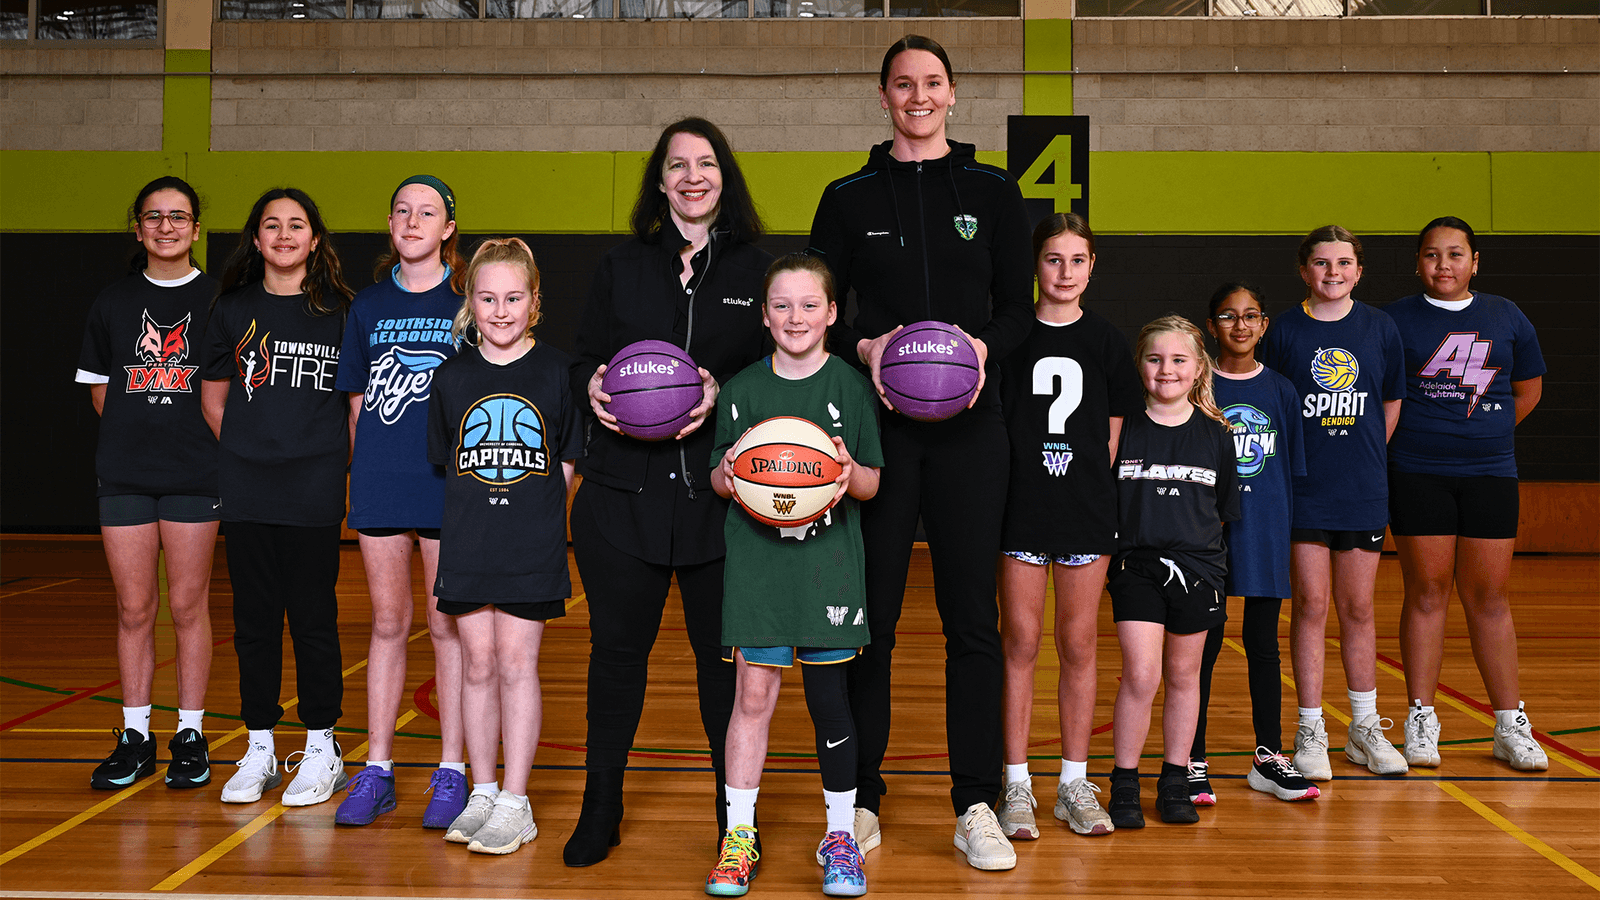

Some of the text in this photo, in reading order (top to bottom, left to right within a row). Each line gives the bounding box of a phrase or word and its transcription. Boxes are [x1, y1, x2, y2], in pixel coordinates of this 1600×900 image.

[1017, 134, 1082, 214] 4
[722, 297, 751, 307] st.lukes
[374, 317, 454, 331] SOUTHSID
[898, 340, 954, 356] st.lukes
[270, 355, 339, 392] FIRE
[619, 360, 675, 377] st.lukes
[128, 367, 194, 390] LYNX
[366, 356, 434, 416] Flye
[1419, 380, 1457, 390] Adelaide
[1424, 389, 1466, 400] Lightning
[1302, 391, 1369, 419] SPIRIT
[1321, 416, 1356, 427] BENDIGO
[1043, 442, 1072, 451] WNBL
[459, 448, 546, 470] CAPITALS
[1118, 464, 1217, 487] FLAMES
